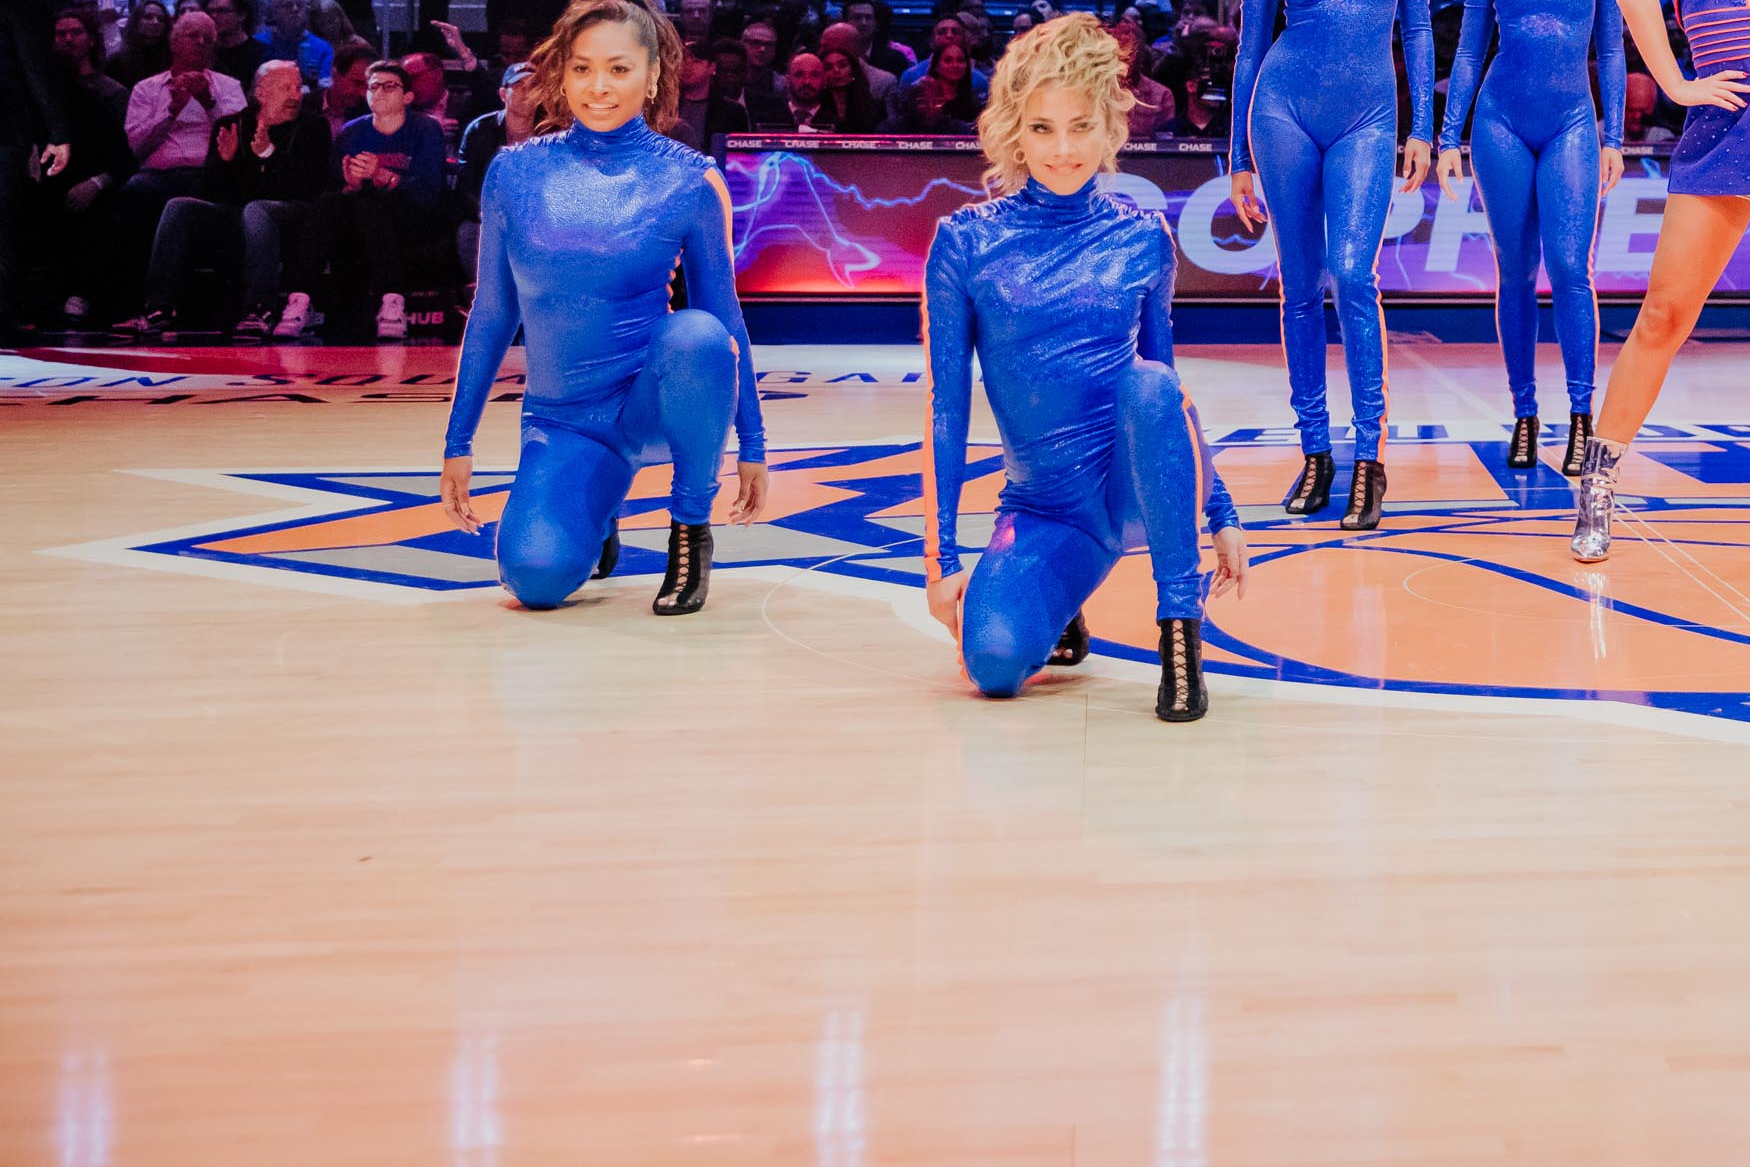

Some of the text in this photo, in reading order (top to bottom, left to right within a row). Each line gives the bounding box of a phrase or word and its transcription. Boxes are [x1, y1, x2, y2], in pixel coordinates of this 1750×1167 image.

[727, 140, 762, 148] CHASE
[785, 140, 820, 148] CHASE
[841, 141, 876, 149] CHASE
[898, 141, 933, 150] CHASE
[955, 141, 981, 150] CHA
[1124, 143, 1157, 151] CHASE
[1179, 143, 1213, 151] CHASE
